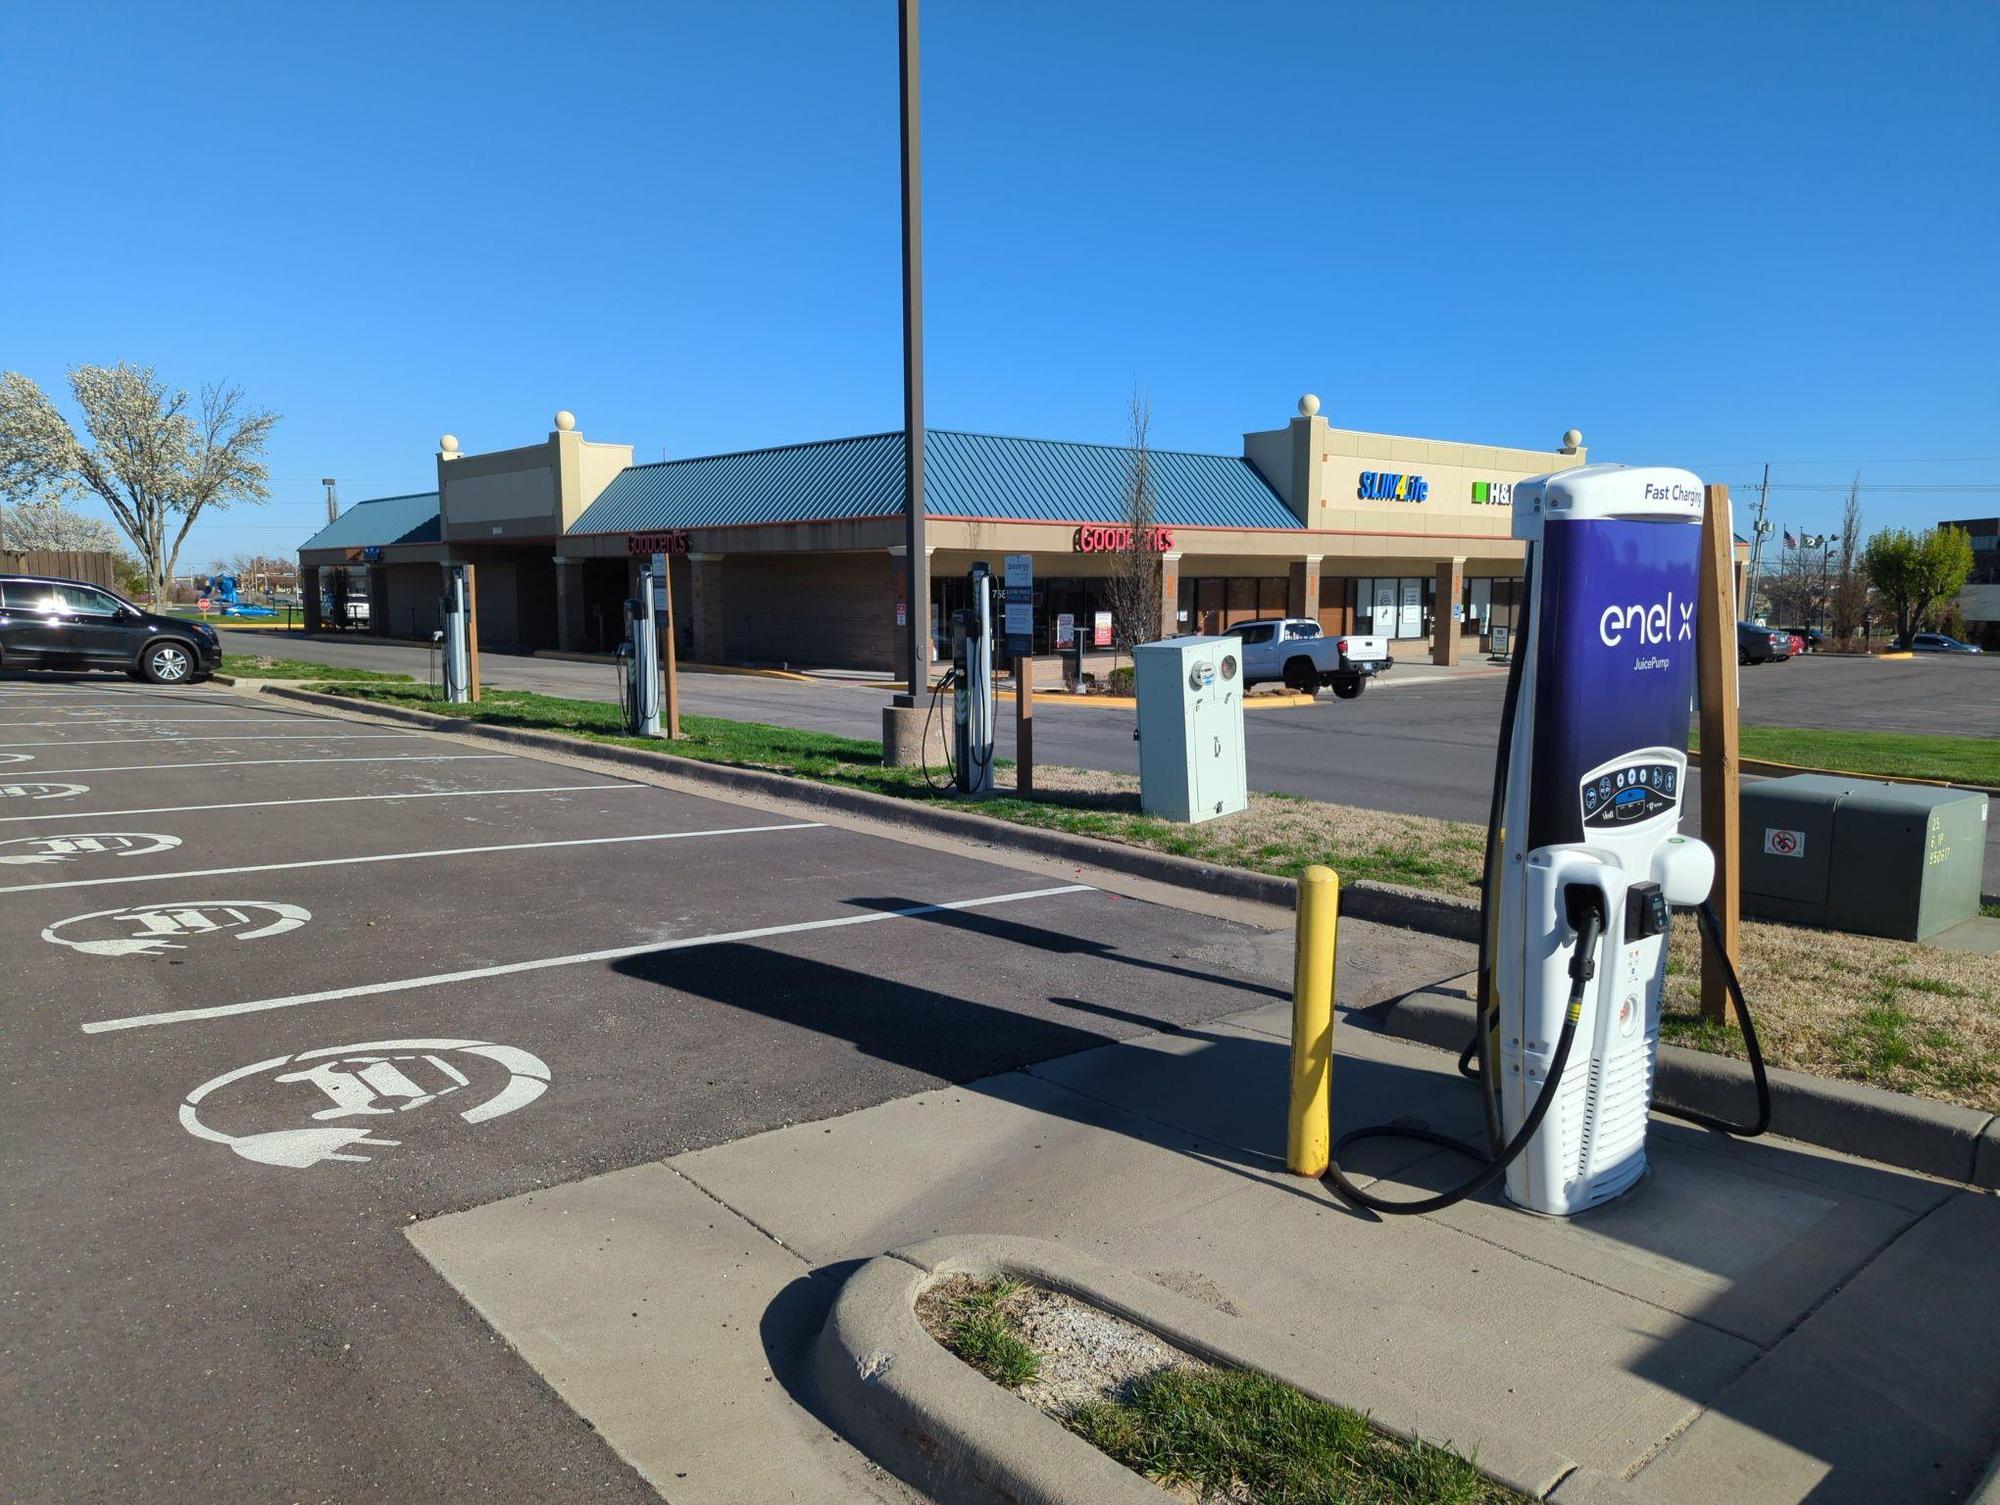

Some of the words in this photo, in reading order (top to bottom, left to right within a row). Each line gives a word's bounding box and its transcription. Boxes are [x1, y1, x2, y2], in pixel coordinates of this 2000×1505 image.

[1645, 484, 1669, 500] Fast
[1672, 485, 1702, 508] Charging
[1600, 591, 1673, 647] enel
[1634, 656, 1670, 671] JuicePump
